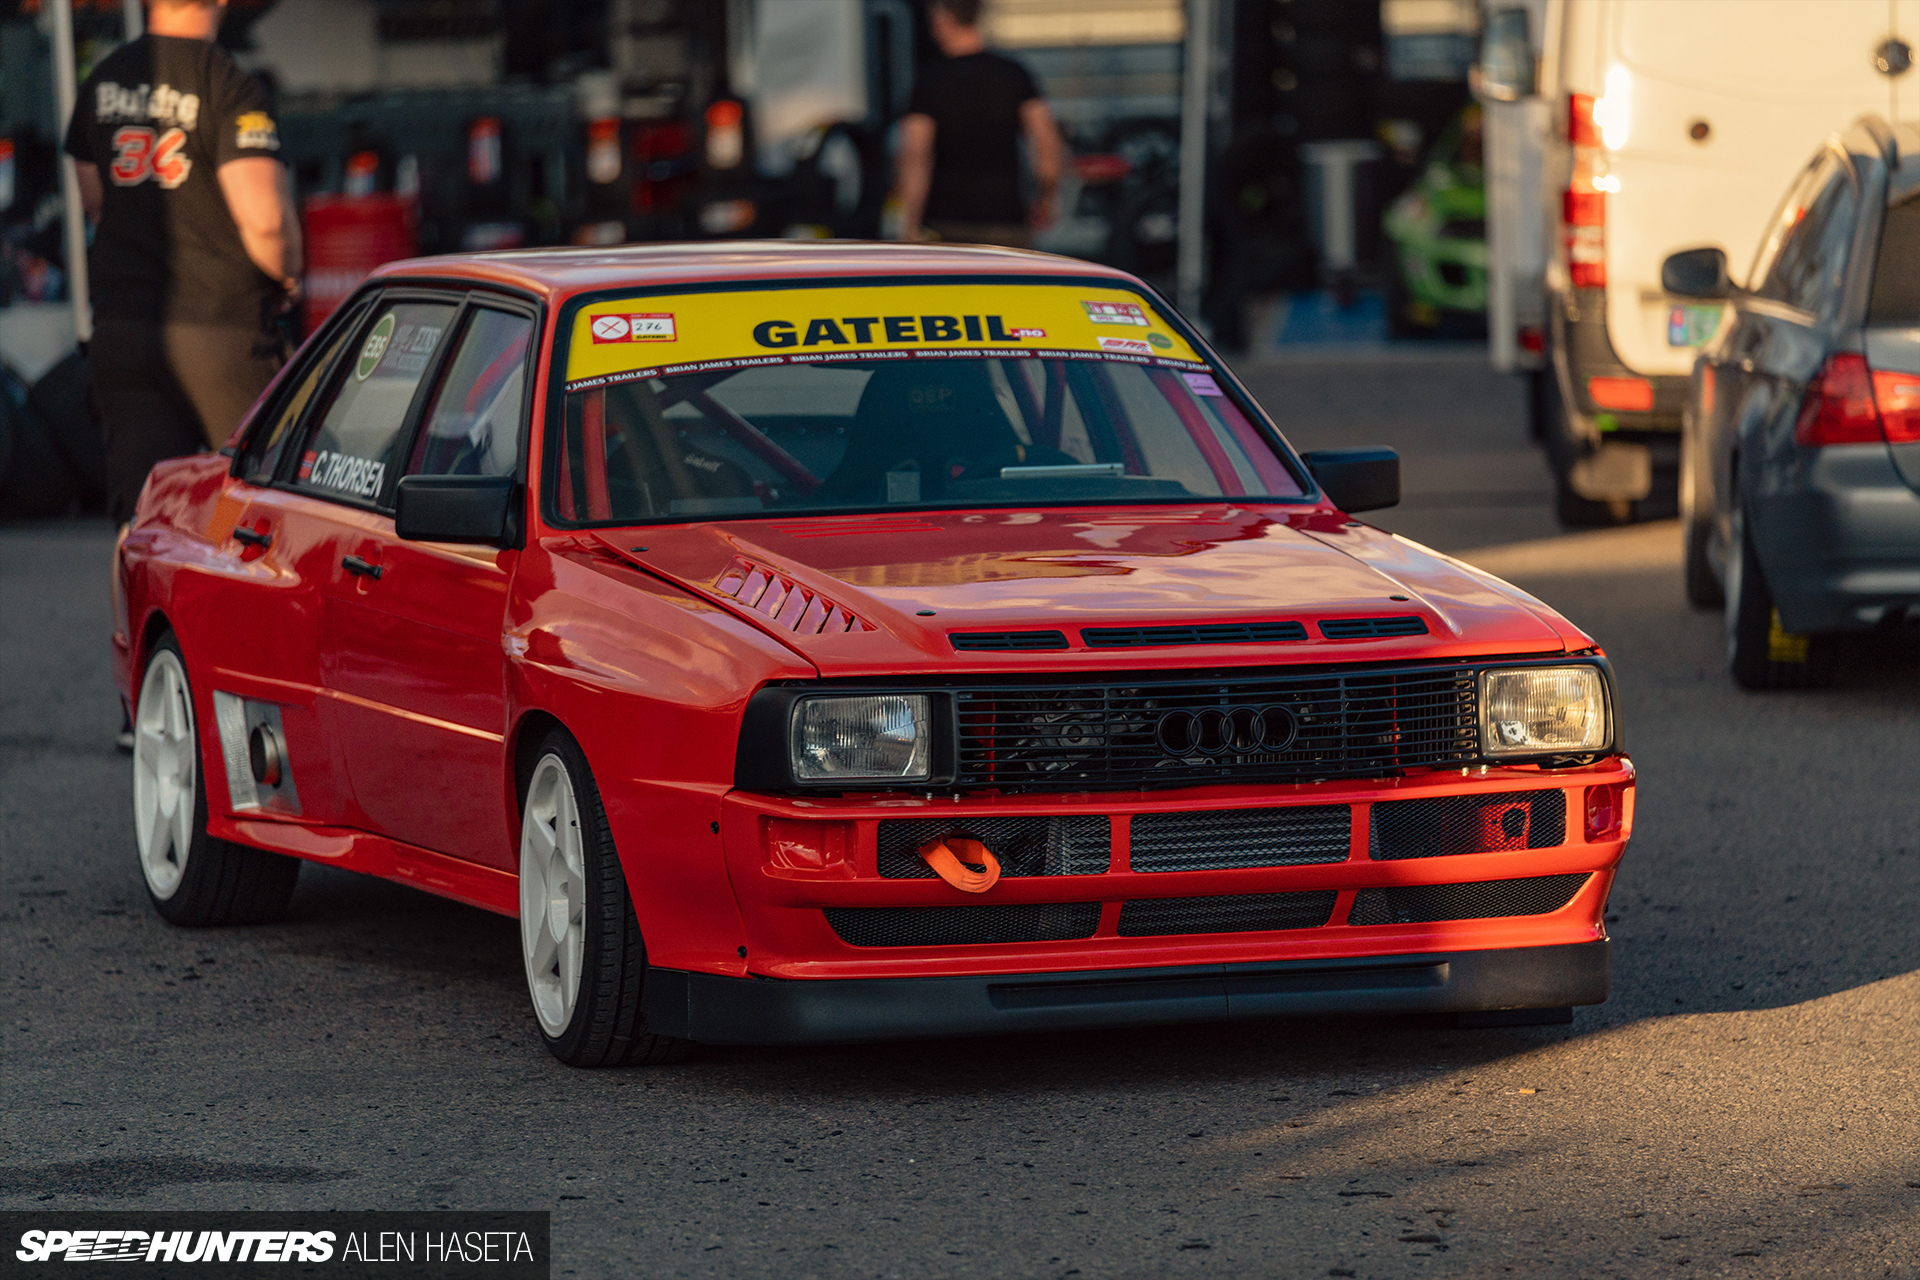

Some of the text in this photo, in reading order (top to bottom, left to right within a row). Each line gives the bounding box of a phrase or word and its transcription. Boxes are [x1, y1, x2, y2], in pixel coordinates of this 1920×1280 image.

[635, 322, 662, 332] 276
[753, 316, 1021, 348] GATEBIL
[363, 334, 388, 359] E85
[790, 350, 909, 363] BRIAN JAMES TRAILERS
[915, 349, 1031, 358] BRIAN JAMES TRAILERS
[1037, 350, 1151, 363] BRIAN JAMES TRAILERS
[664, 356, 784, 374] BRIAN JAMES TRAILERS
[1156, 358, 1187, 367] BRIAN
[571, 377, 606, 390] JAMES
[607, 368, 658, 383] TRAILERS
